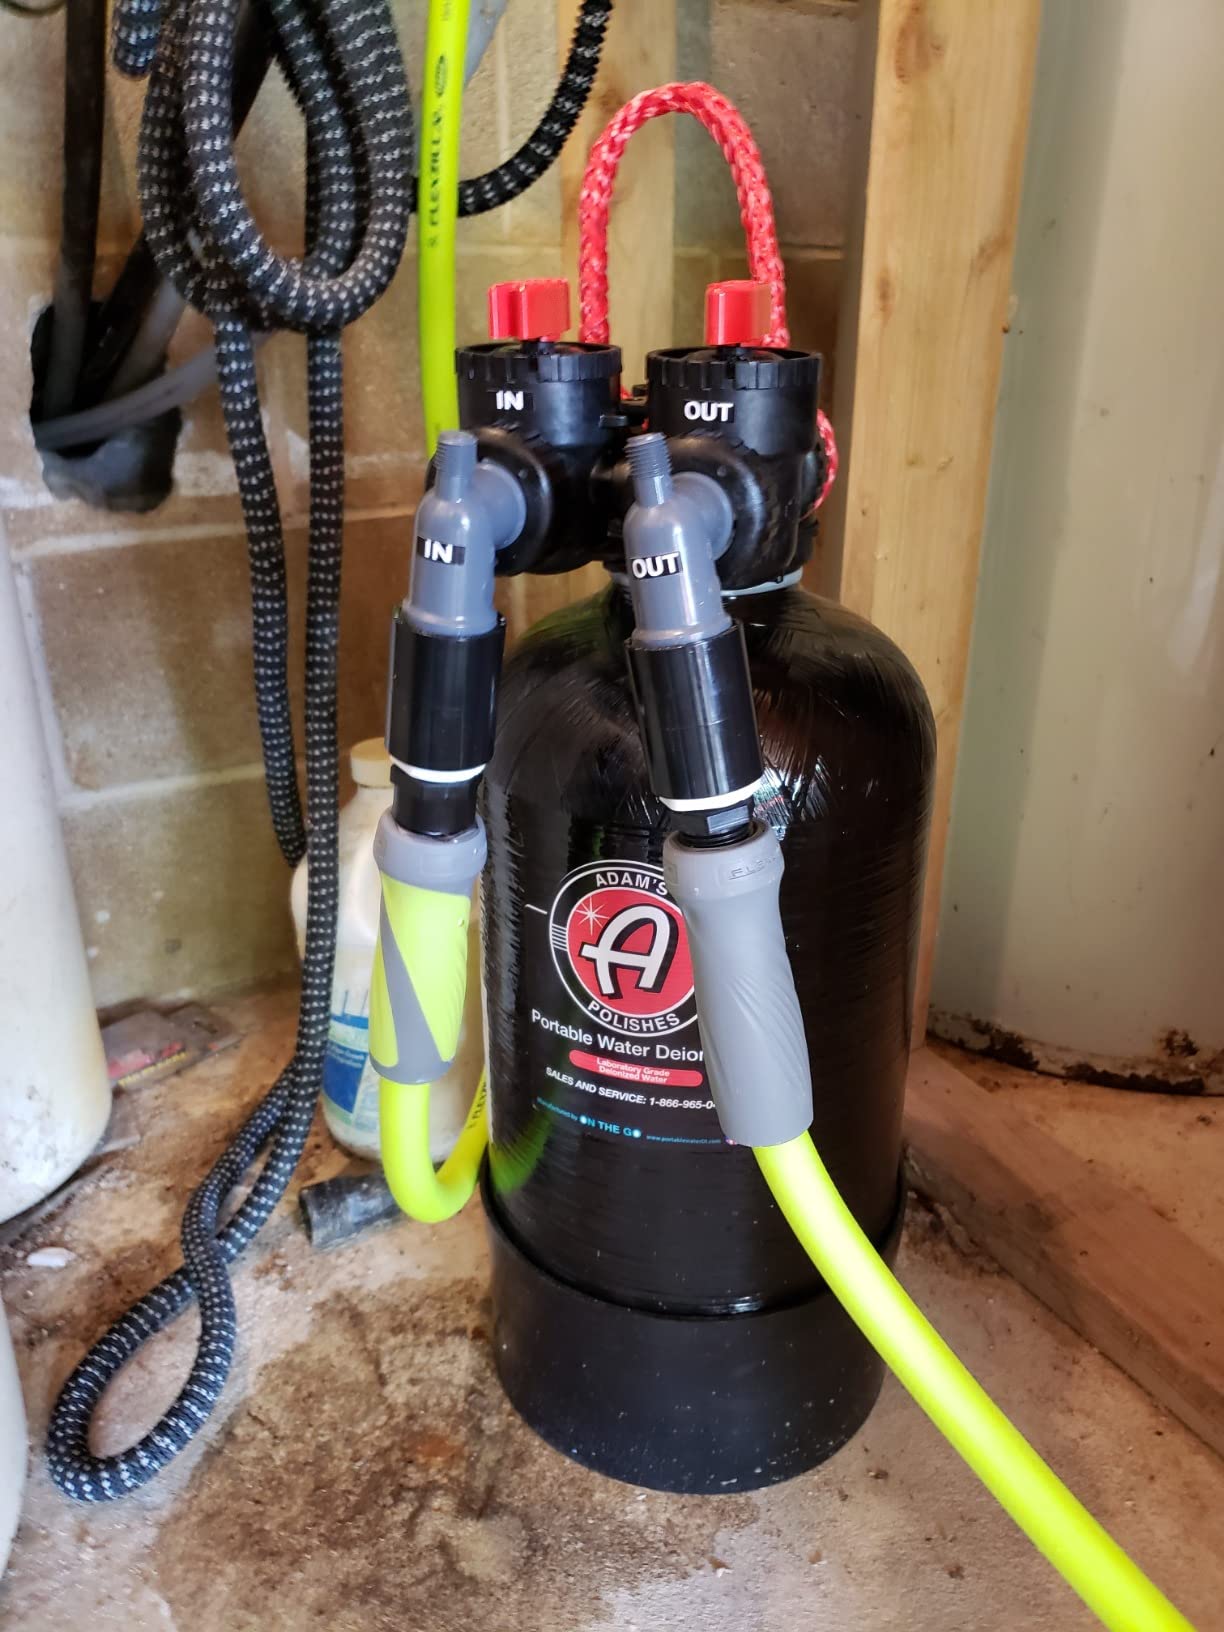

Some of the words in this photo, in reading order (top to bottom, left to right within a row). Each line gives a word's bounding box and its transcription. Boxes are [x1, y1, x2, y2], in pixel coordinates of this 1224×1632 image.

[495, 390, 525, 411] IN
[683, 401, 734, 422] OUT
[423, 540, 453, 563] IN
[631, 553, 679, 579] OUT
[595, 871, 668, 896] ADAM'S
[588, 1000, 680, 1032] POLISHES
[531, 1008, 593, 1046] Portable
[597, 1033, 650, 1057] Water
[596, 1057, 641, 1074] Laboratory
[643, 1067, 671, 1077] Grade
[598, 1065, 640, 1081] Deionized
[641, 1073, 668, 1084] Water
[545, 1066, 574, 1086] SALES
[574, 1080, 597, 1094] AND
[598, 1086, 648, 1105] SERVICE:
[649, 1096, 716, 1111] 1-866-965-0
[598, 1120, 620, 1135] THE
